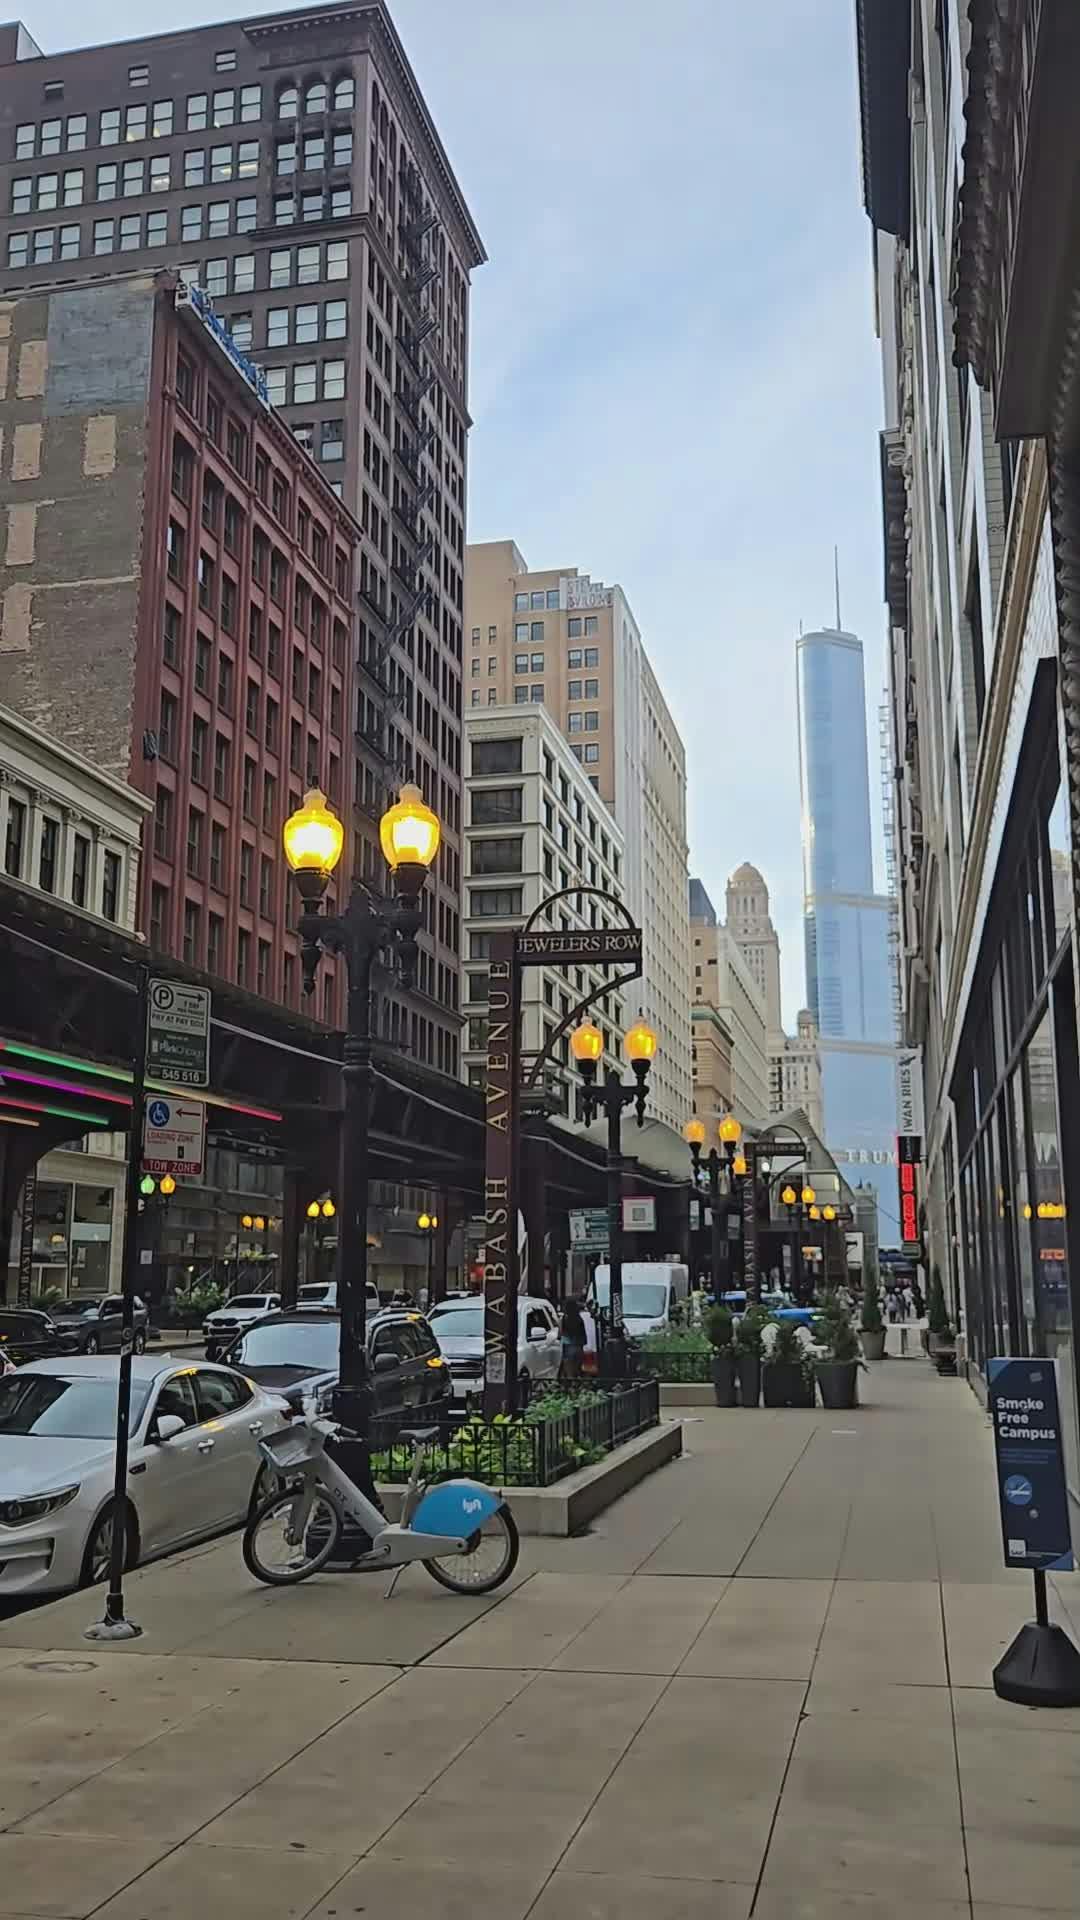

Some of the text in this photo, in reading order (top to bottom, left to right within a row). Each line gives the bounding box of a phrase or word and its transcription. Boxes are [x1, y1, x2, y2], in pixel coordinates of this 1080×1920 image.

[516, 934, 642, 953] JEWELERS ROW
[901, 1069, 911, 1097] RIES
[903, 1100, 913, 1132] IWAN
[485, 960, 510, 1354] WABASH AVENUE
[845, 1149, 898, 1165] TRUM
[149, 1160, 197, 1174] TOW ZONE
[997, 1398, 1044, 1411] Smoke
[998, 1412, 1029, 1425] Free
[999, 1426, 1056, 1441] Campus
[462, 1498, 482, 1514] lyft
